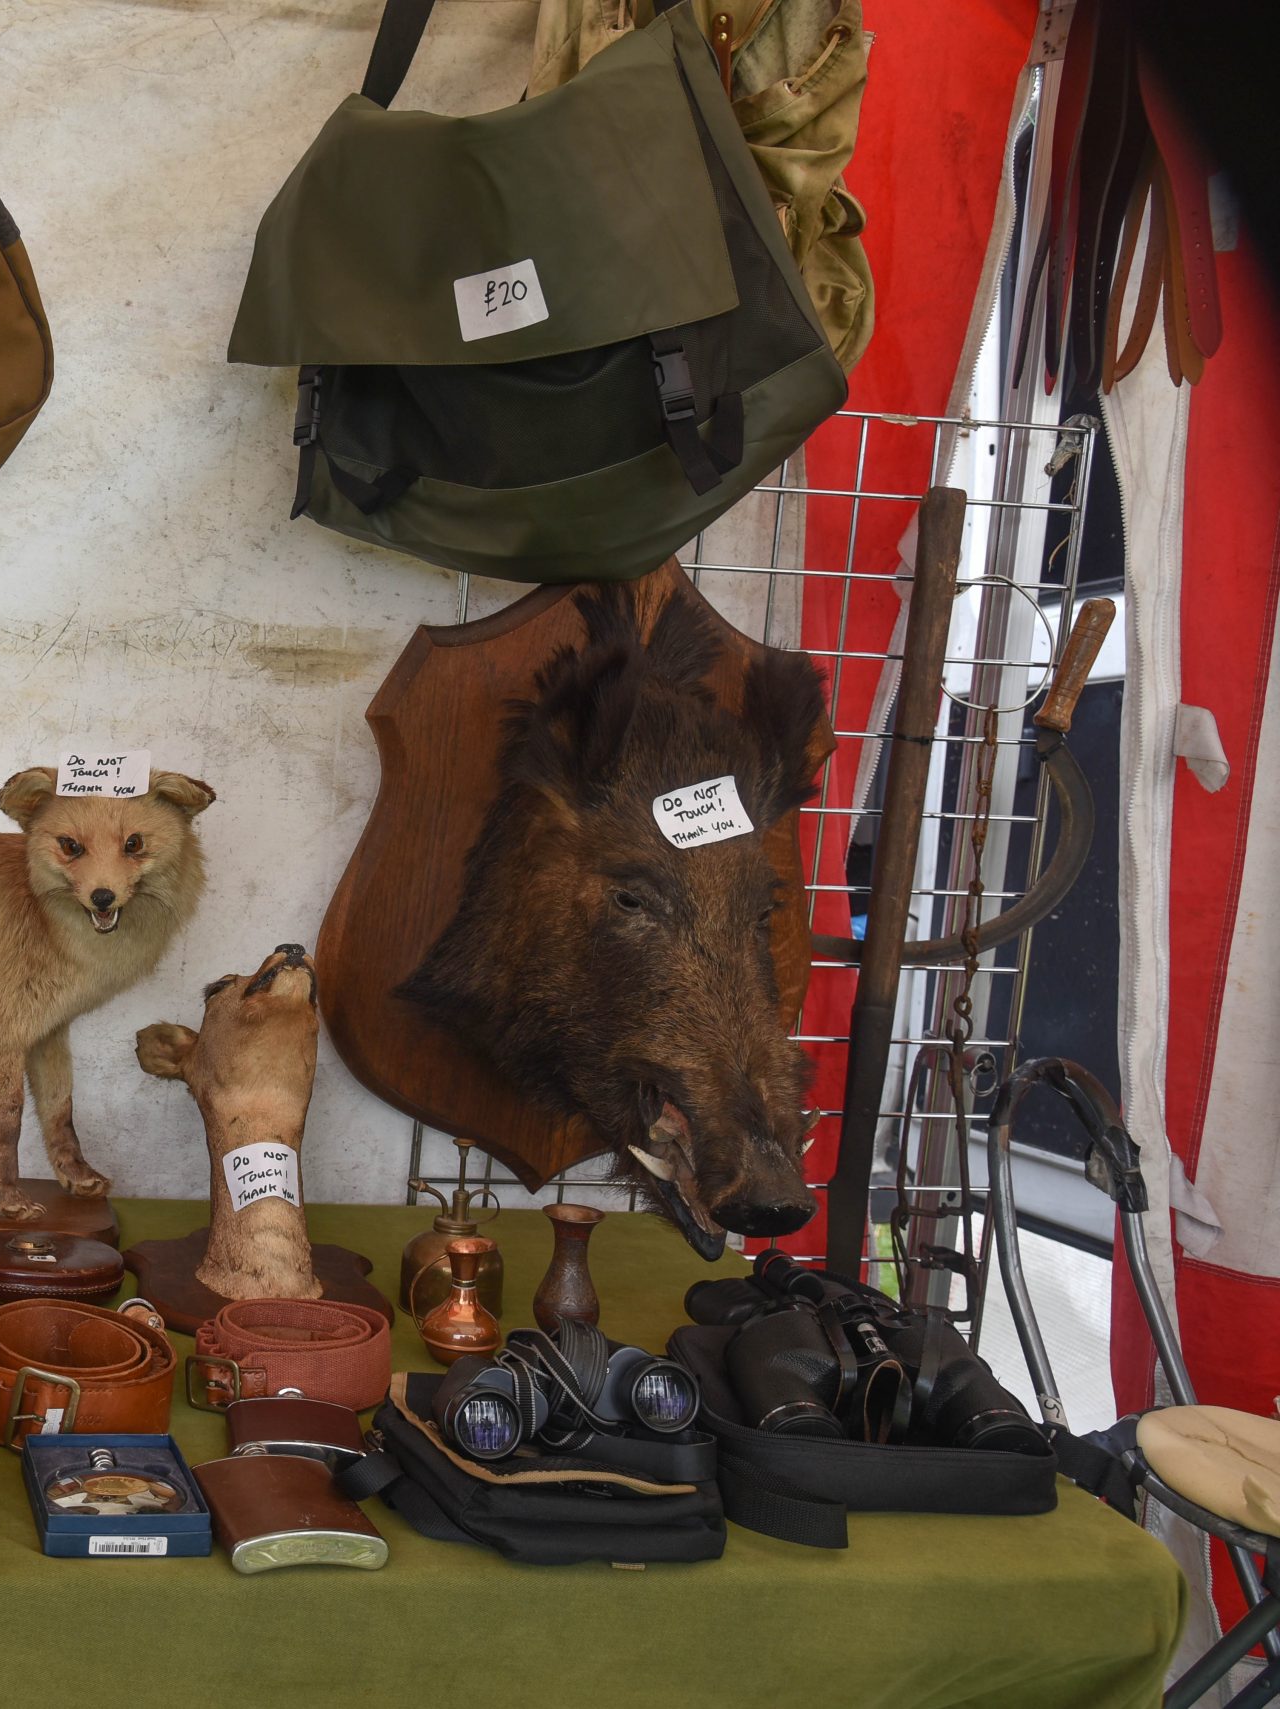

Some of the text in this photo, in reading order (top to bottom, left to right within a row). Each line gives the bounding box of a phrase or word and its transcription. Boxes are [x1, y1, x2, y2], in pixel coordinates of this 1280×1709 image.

[484, 280, 527, 317] £20
[97, 756, 127, 766] NOT
[62, 782, 136, 797] THANK YOU
[662, 782, 722, 812] DO NOT
[674, 797, 725, 822] TOUCH!
[671, 825, 708, 844] THANK
[232, 1151, 289, 1171] DO NOT
[238, 1183, 295, 1206] THANK YOU
